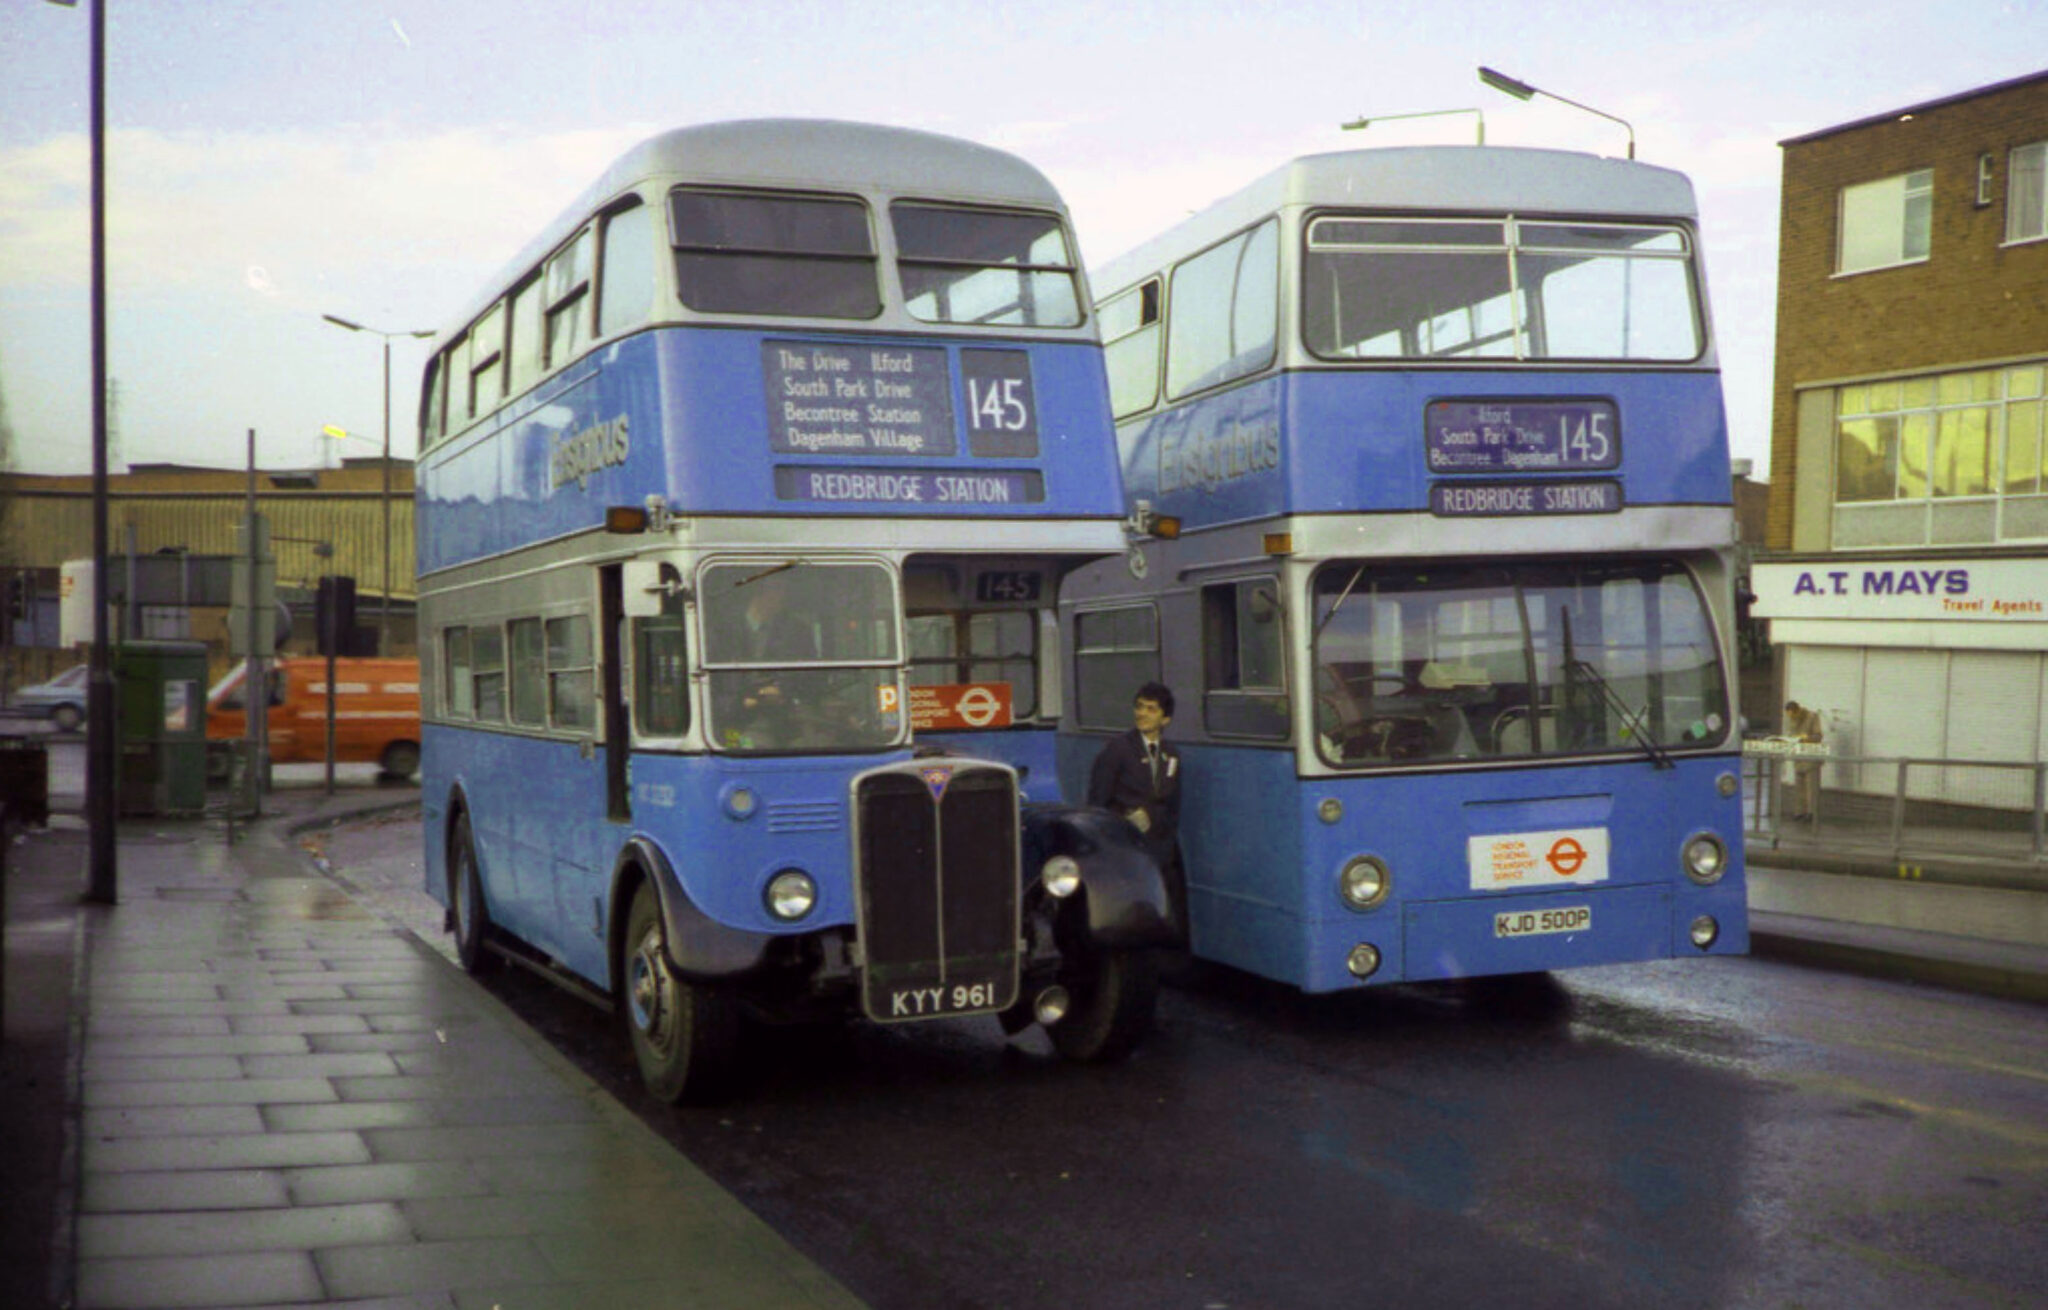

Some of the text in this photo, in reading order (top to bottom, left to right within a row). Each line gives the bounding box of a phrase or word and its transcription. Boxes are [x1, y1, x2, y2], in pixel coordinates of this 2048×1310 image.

[778, 349, 913, 373] The Drive Ilford
[783, 377, 912, 399] South Park Drive
[784, 401, 922, 424] Becontree Station
[968, 378, 1028, 431] 145
[788, 427, 924, 452] Dagenham Village
[1440, 427, 1477, 445] South
[1560, 413, 1609, 462] 145
[810, 473, 1010, 503] REDBRIDGE STATION
[1443, 486, 1604, 512] REDBRIDGE STATION
[1862, 569, 1969, 594] MAYS
[1943, 598, 2043, 615] Travel Agents
[1497, 909, 1589, 935] KJD 500P
[892, 982, 993, 1015] KYY 961
